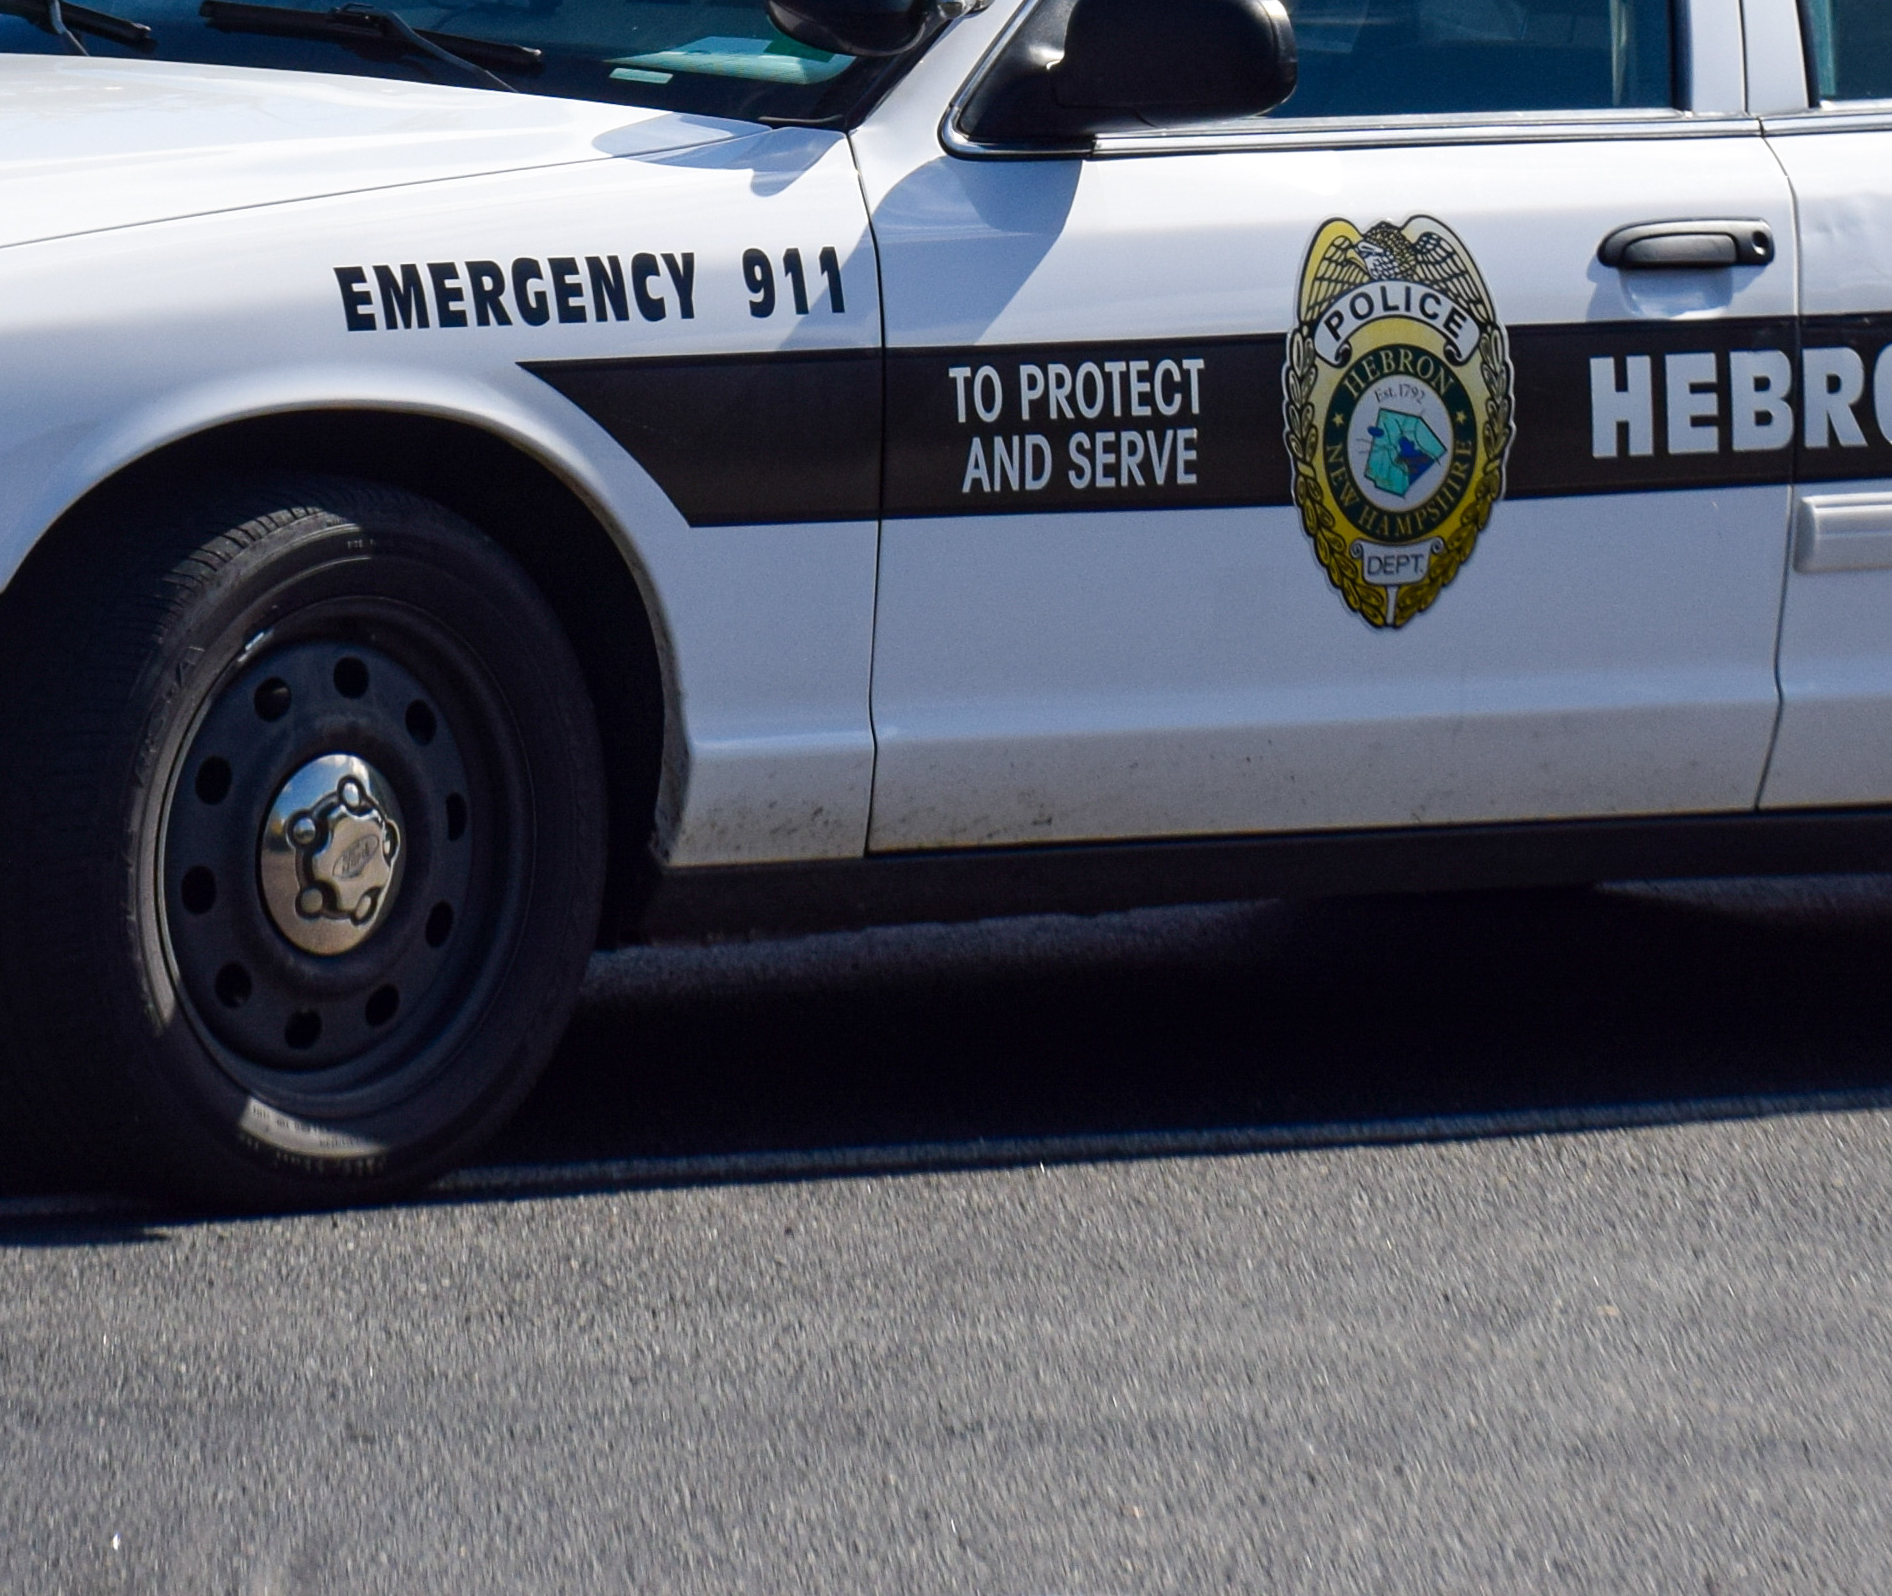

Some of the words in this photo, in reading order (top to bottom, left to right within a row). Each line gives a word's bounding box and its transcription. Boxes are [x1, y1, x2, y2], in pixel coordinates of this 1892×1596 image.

[334, 252, 696, 332] EMERGENCY
[742, 246, 847, 319] 911
[1323, 284, 1469, 343] POLICE
[948, 365, 1004, 424] TO
[1019, 358, 1206, 421] PROTECT
[1344, 348, 1454, 398] HEBRON
[1398, 383, 1426, 404] 1792
[962, 434, 1053, 494] AND
[1068, 428, 1199, 489] SERVE
[1326, 441, 1360, 507] NEW
[1357, 439, 1472, 536] HAMPSHIRE
[1366, 554, 1426, 576] DEPT.
